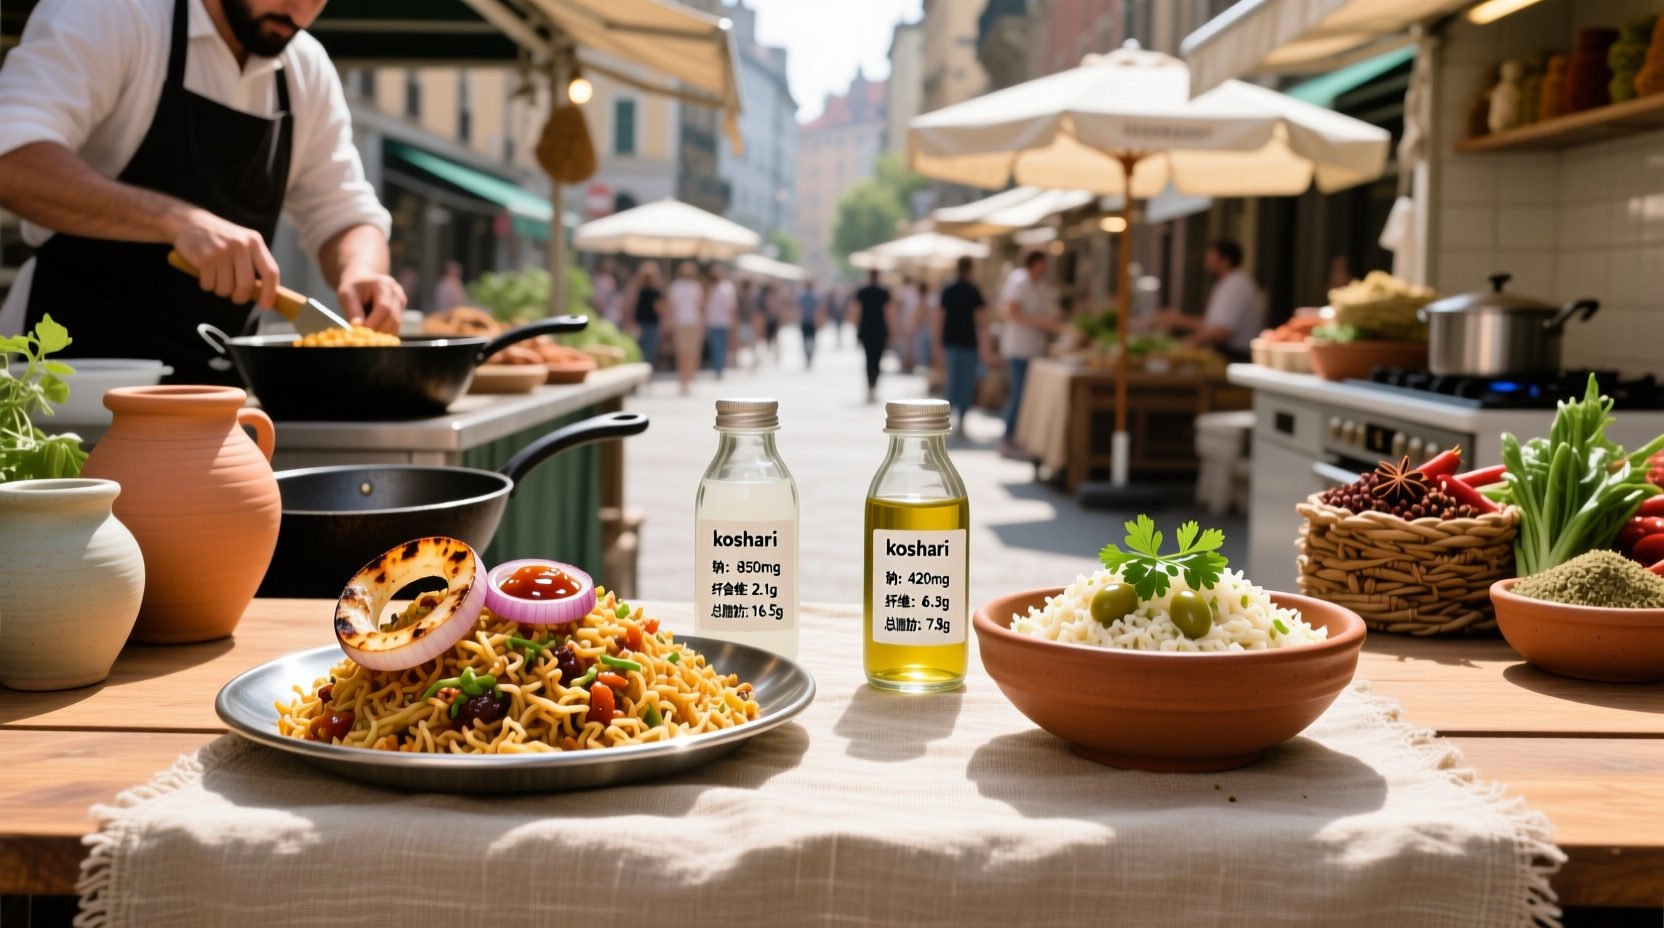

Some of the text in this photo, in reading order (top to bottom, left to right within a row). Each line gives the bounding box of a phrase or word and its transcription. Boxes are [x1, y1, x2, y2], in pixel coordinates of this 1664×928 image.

[713, 529, 777, 547] koshari
[886, 538, 949, 557] koshari
[737, 560, 781, 576] 850mg
[907, 571, 950, 588] 420mg
[751, 583, 778, 598] 2.1g
